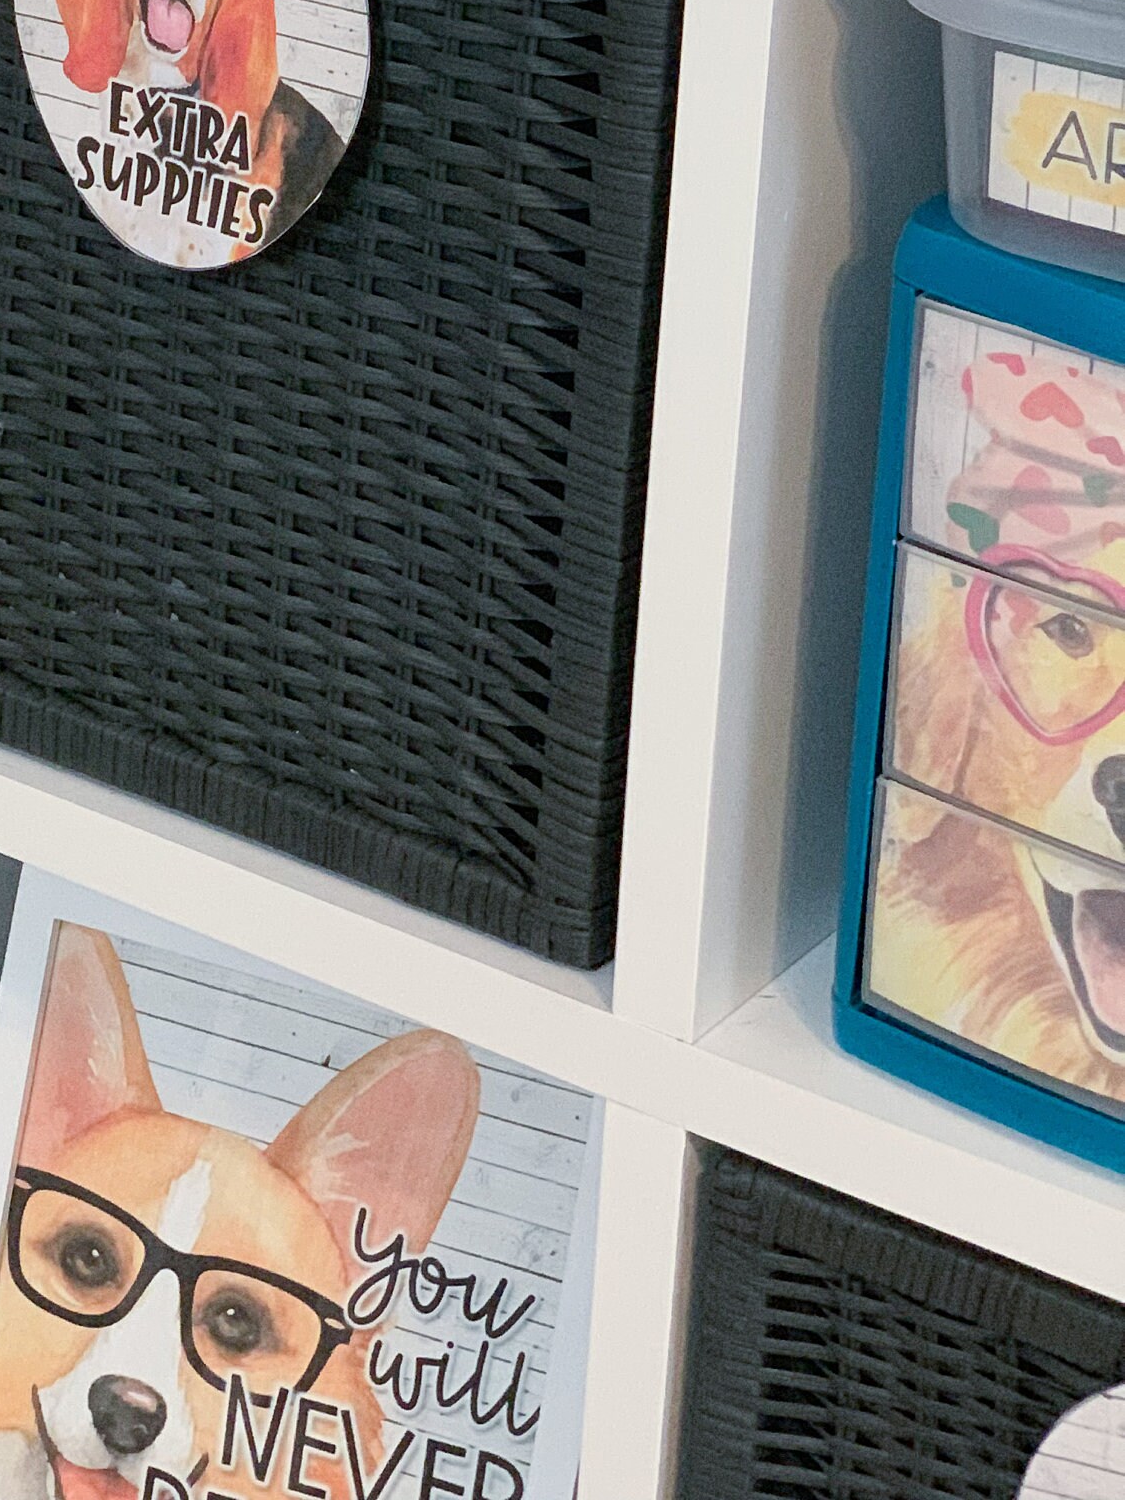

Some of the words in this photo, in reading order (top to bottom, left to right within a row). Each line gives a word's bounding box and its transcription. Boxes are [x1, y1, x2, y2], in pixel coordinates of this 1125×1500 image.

[109, 81, 252, 171] EXTRA
[76, 136, 275, 244] SUPPLIES
[347, 1206, 536, 1339] you
[369, 1334, 541, 1436] will
